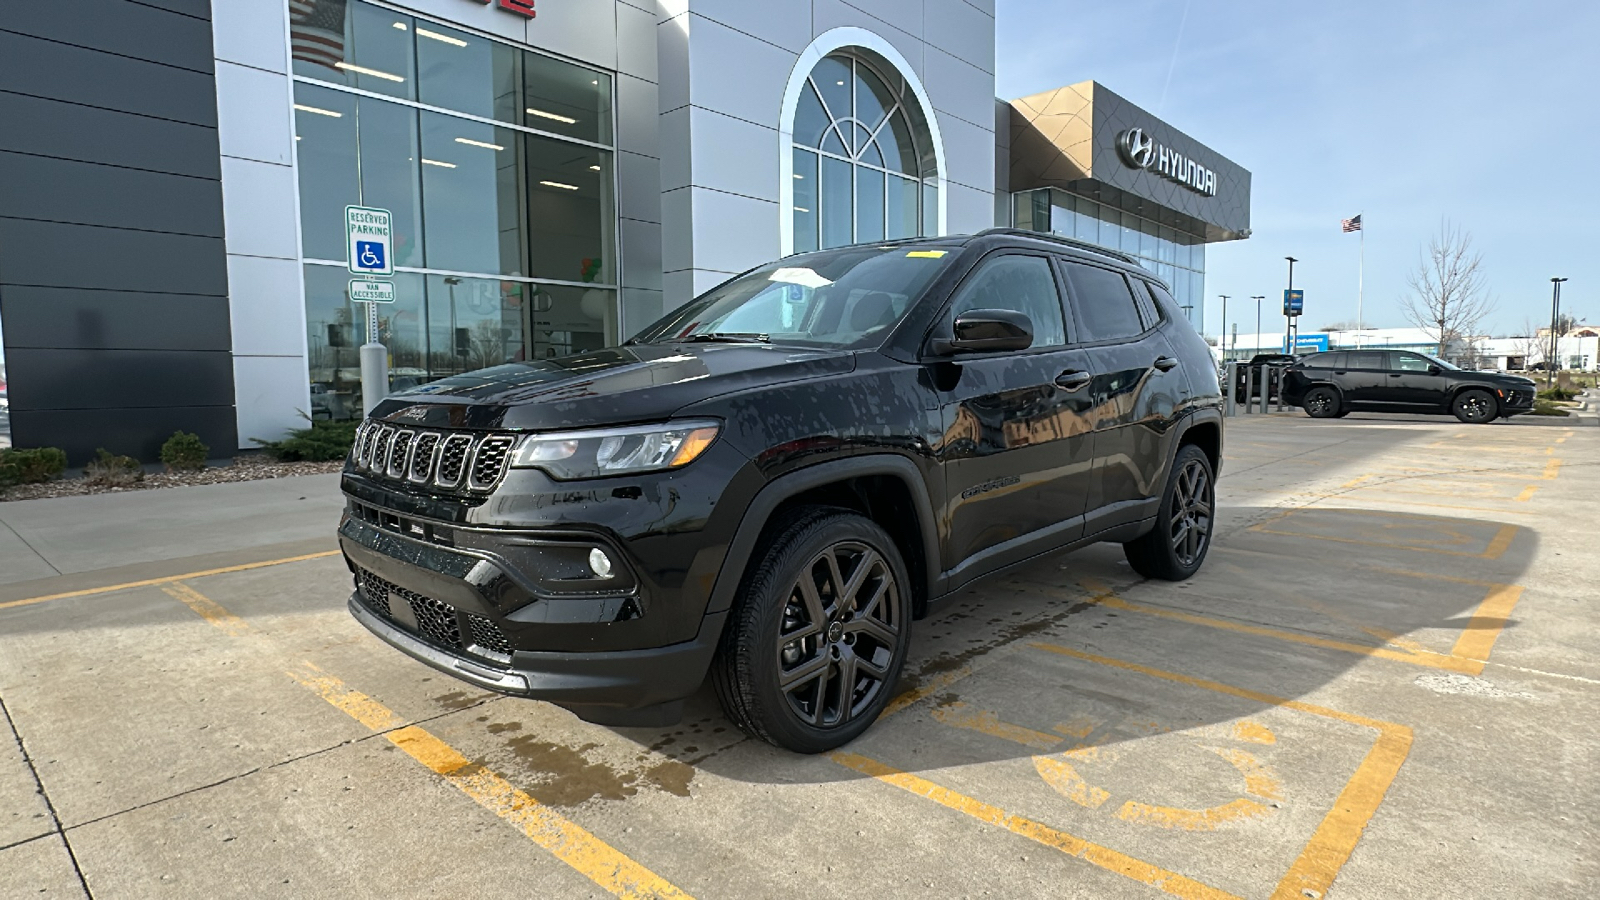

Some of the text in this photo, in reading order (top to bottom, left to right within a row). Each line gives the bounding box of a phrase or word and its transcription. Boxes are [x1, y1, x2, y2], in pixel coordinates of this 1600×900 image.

[1158, 144, 1216, 196] HYUNDAI
[350, 212, 387, 225] RESERVED
[351, 224, 388, 236] PARKING
[353, 290, 392, 299] ACCESSIBLE
